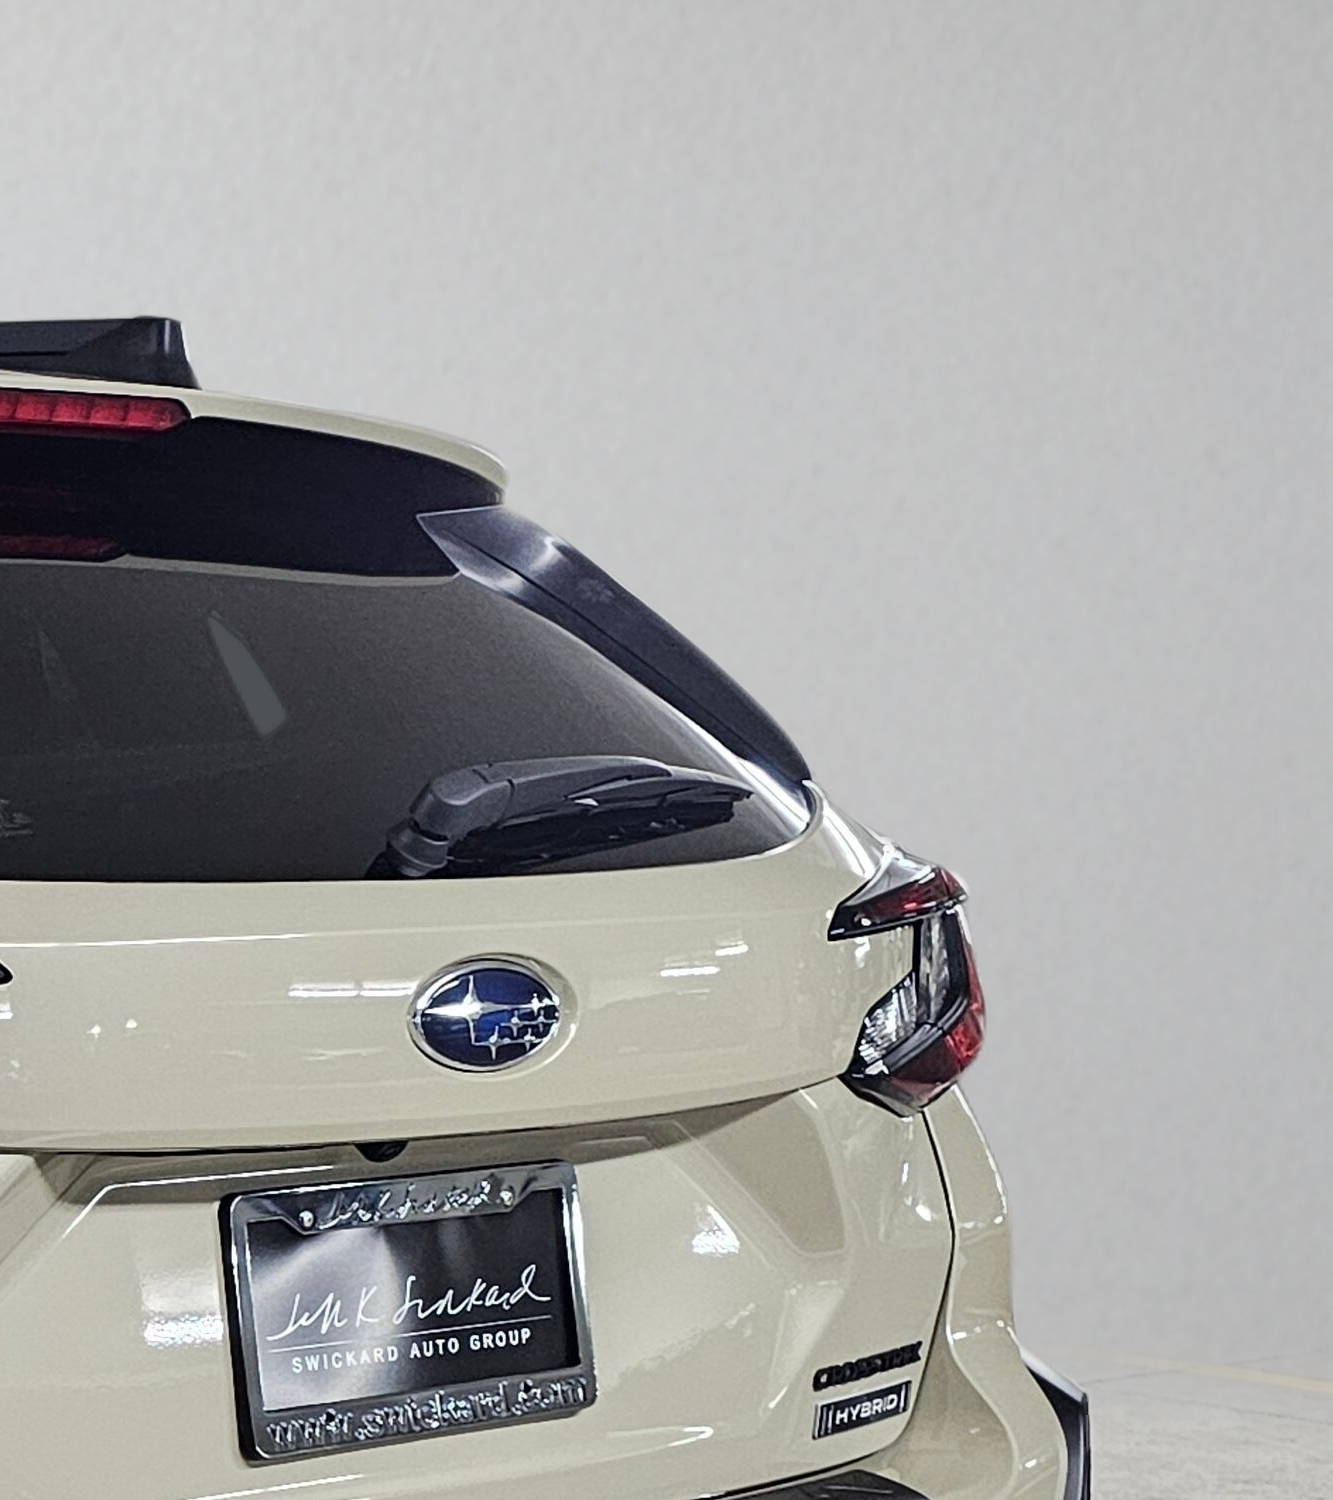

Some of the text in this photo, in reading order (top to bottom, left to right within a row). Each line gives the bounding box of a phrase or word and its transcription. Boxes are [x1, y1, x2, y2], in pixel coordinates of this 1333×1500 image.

[291, 1328, 532, 1374] SWICKARD AUTO GROUP
[835, 1394, 898, 1425] HYBRID
